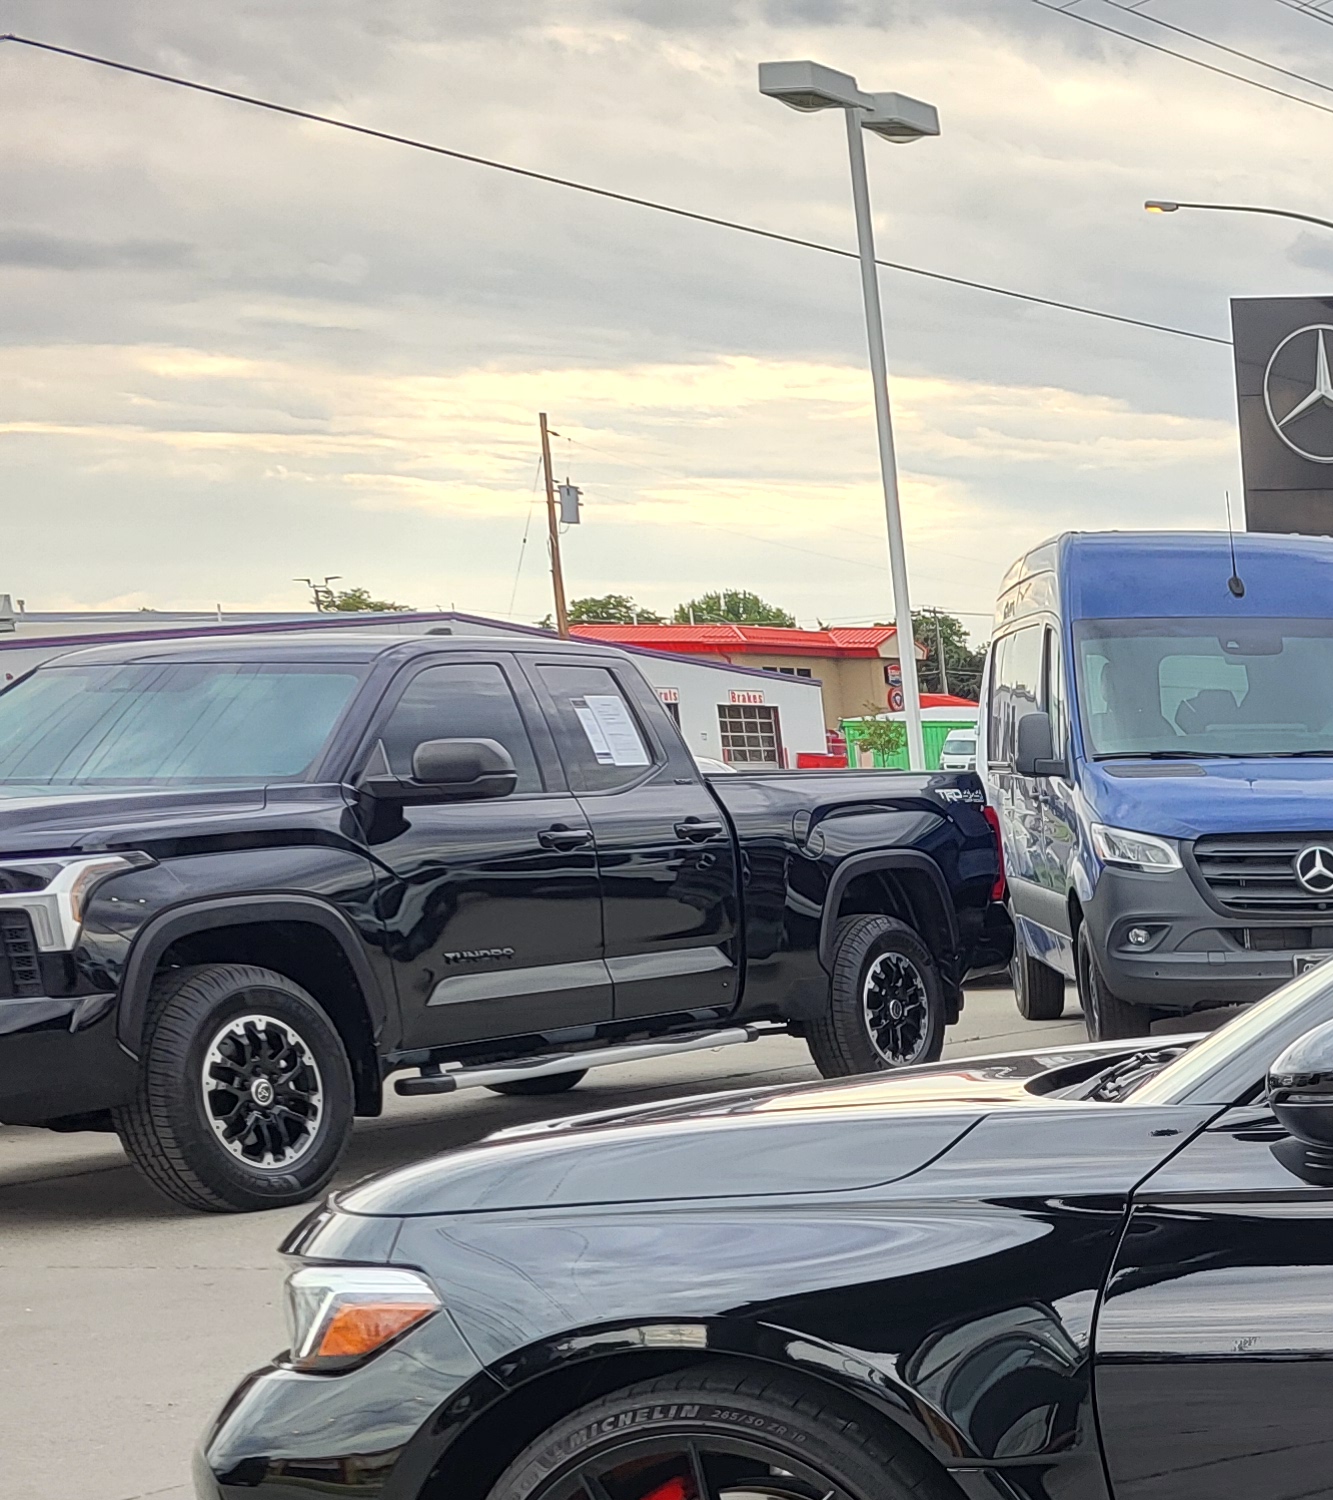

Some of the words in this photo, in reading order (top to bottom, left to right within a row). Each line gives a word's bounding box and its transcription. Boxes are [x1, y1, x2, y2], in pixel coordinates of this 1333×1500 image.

[730, 690, 763, 704] Brakes
[934, 788, 962, 803] TRD
[568, 1404, 700, 1448] MICHELIN
